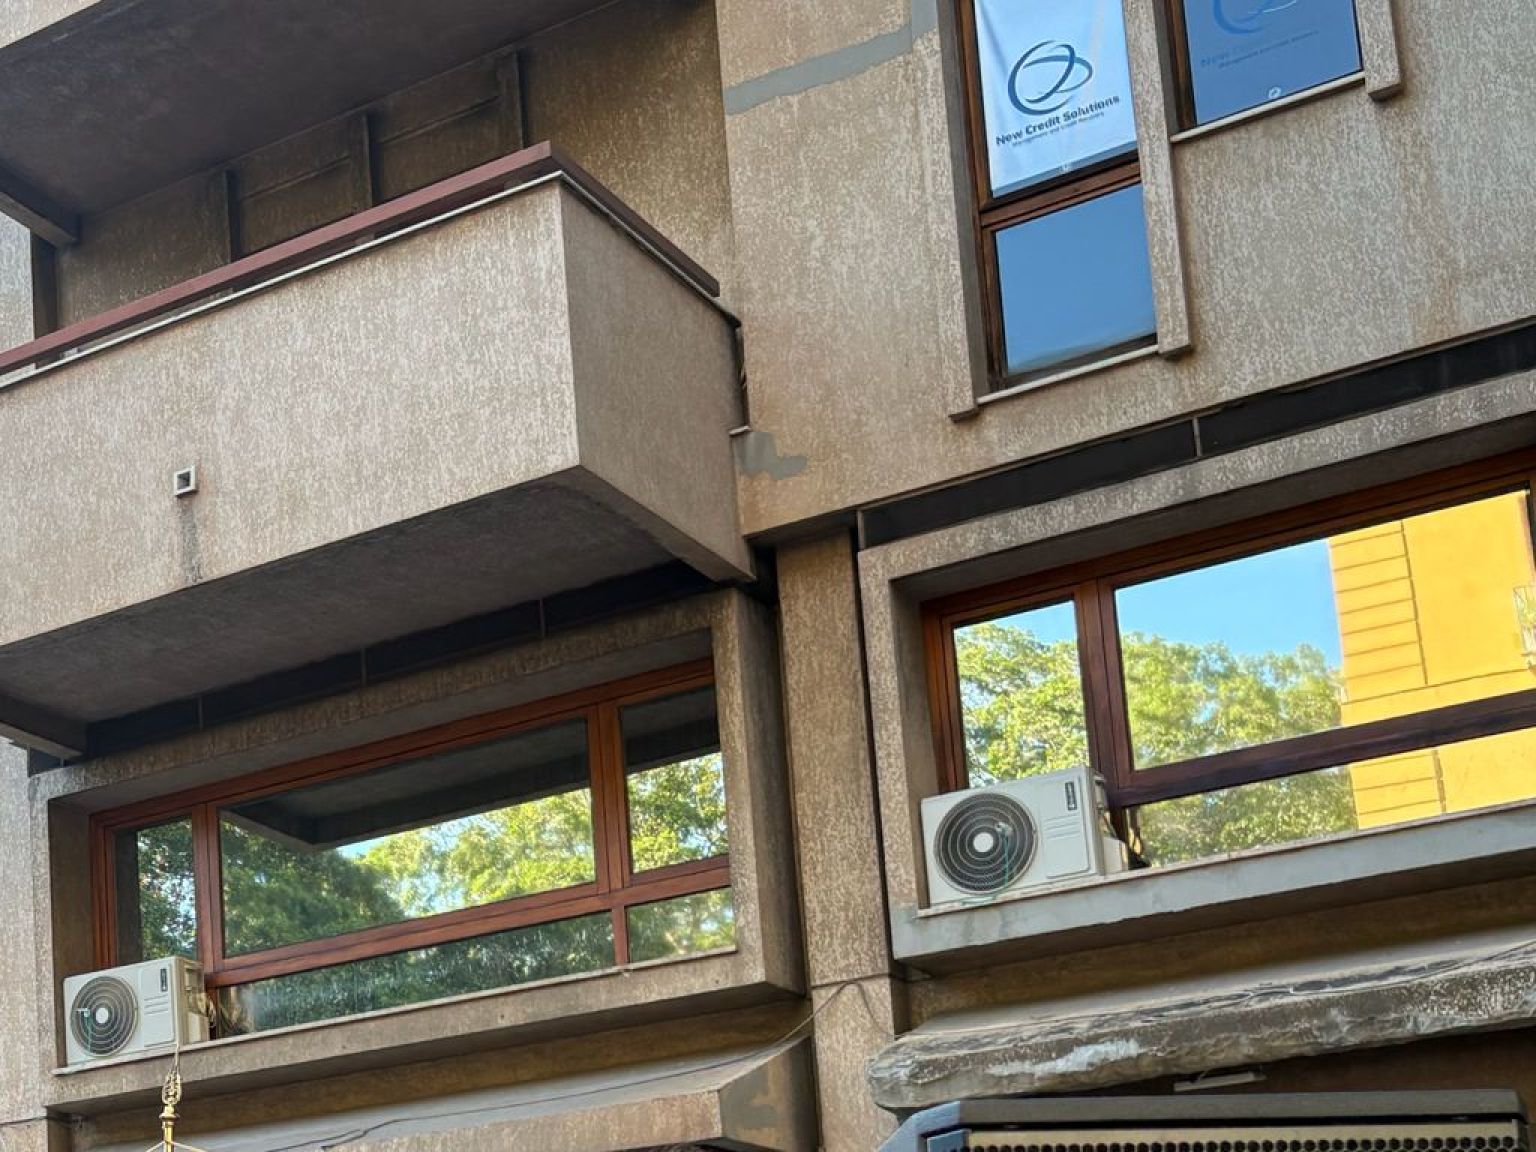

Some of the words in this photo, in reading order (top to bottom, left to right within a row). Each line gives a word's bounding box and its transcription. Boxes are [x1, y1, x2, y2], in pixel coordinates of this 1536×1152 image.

[995, 129, 1023, 146] New
[1025, 115, 1060, 135] Credit
[1062, 95, 1120, 122] Solutions
